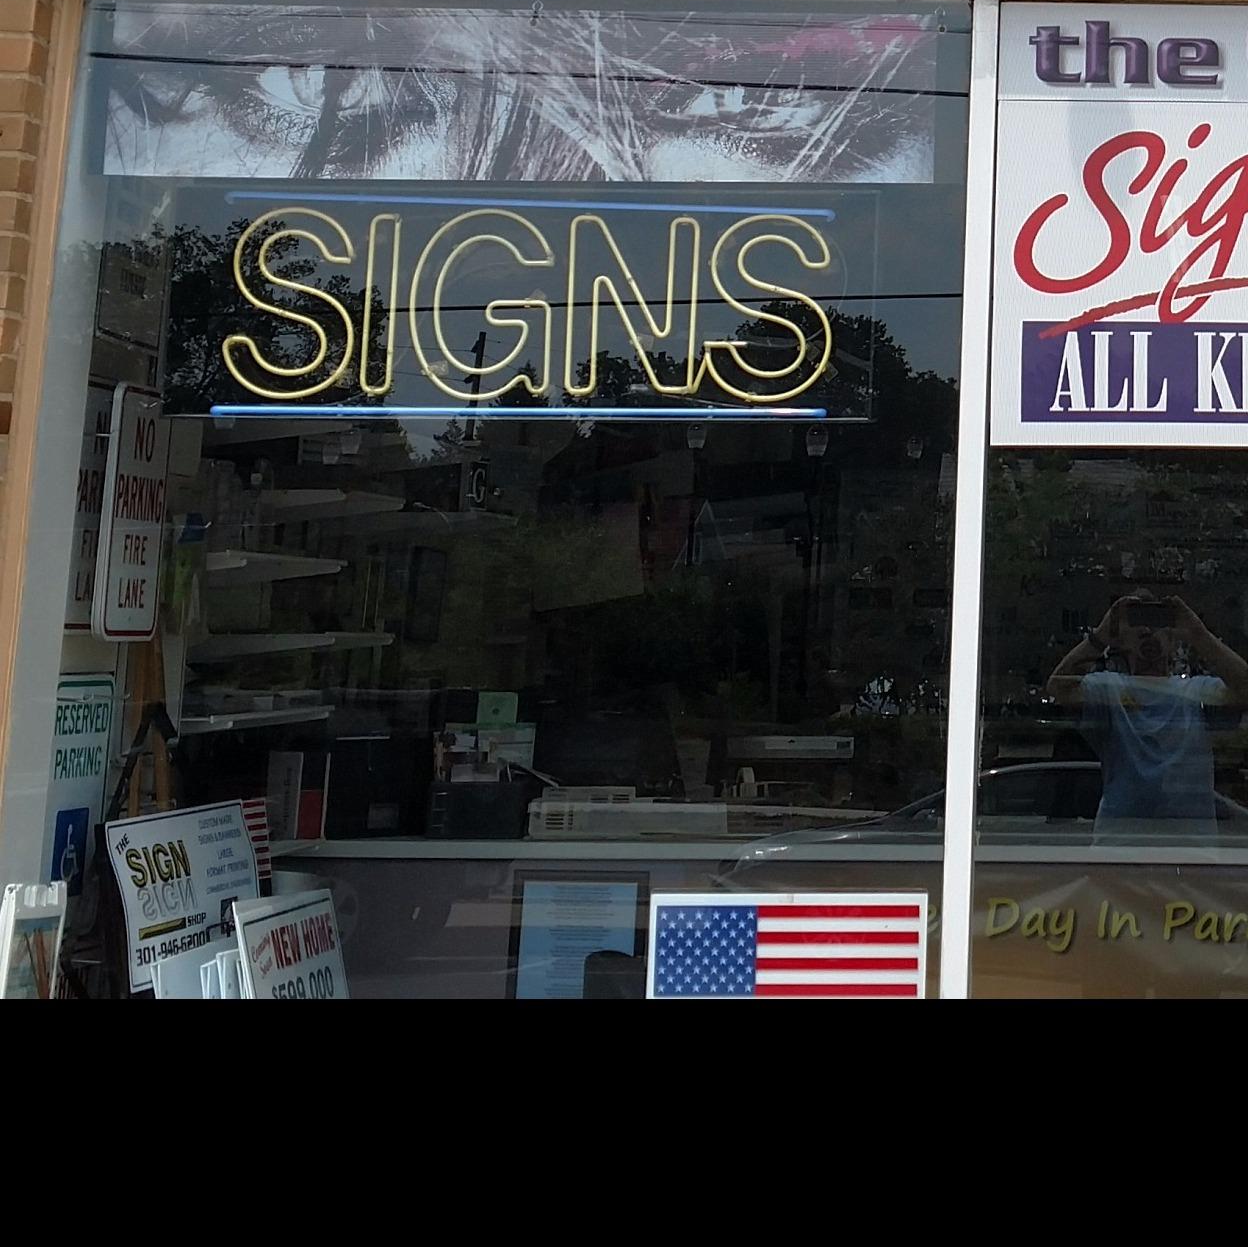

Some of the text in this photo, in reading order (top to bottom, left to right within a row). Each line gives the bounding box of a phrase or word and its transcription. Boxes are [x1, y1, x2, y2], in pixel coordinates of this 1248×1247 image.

[1028, 20, 1224, 86] the
[222, 206, 834, 403] SIGNS
[1049, 331, 1168, 412] ALL
[133, 415, 156, 463] NO
[114, 472, 164, 524] PARKING
[123, 534, 149, 566] FIRE
[118, 577, 146, 609] LANE
[54, 703, 109, 736] RESERVED
[53, 744, 102, 780] PARKING
[115, 833, 130, 855] THE
[126, 840, 191, 888] SIGN
[187, 912, 206, 927] SHOP
[271, 912, 336, 970] NEW HOME
[985, 897, 1076, 952] Day
[1097, 900, 1142, 940] In
